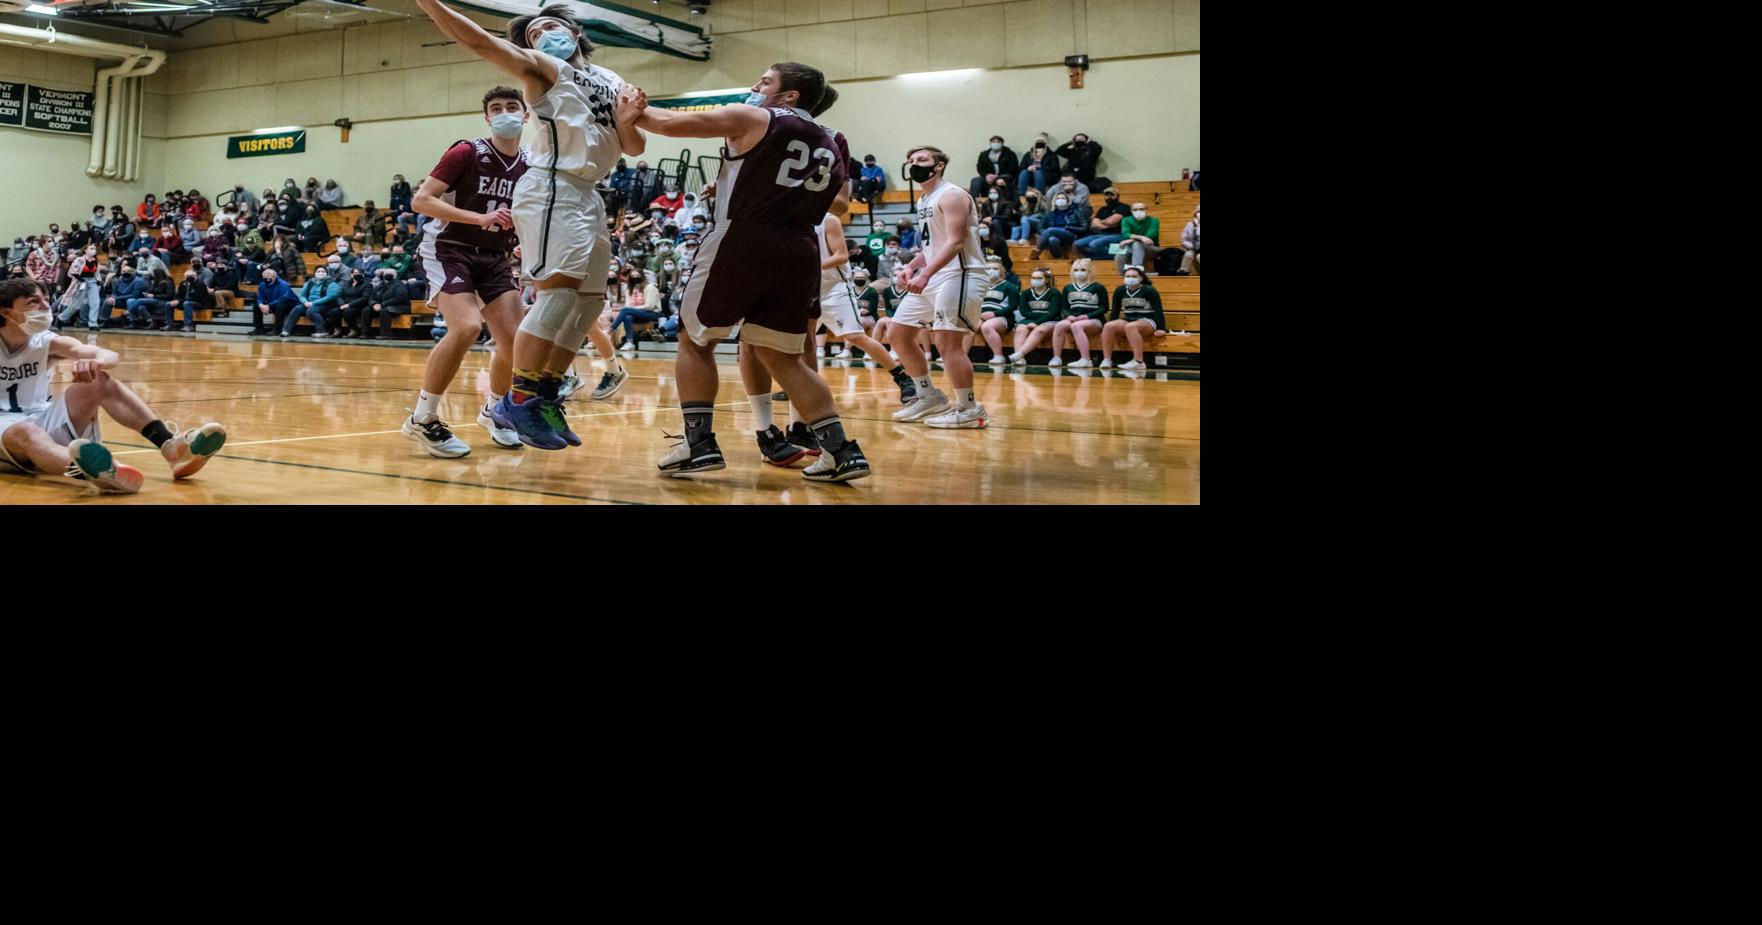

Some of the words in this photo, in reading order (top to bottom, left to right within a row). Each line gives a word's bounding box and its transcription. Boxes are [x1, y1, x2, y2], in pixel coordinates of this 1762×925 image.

[38, 89, 87, 101] VERMONT
[40, 97, 73, 107] DIVISION
[29, 102, 51, 113] STATE
[33, 112, 88, 124] SOFTBALL
[48, 122, 72, 130] 2007
[239, 136, 294, 153] VISITORS
[775, 139, 836, 193] 23
[477, 175, 513, 199] EAGL
[921, 222, 930, 247] 4
[0, 383, 23, 413] 1
